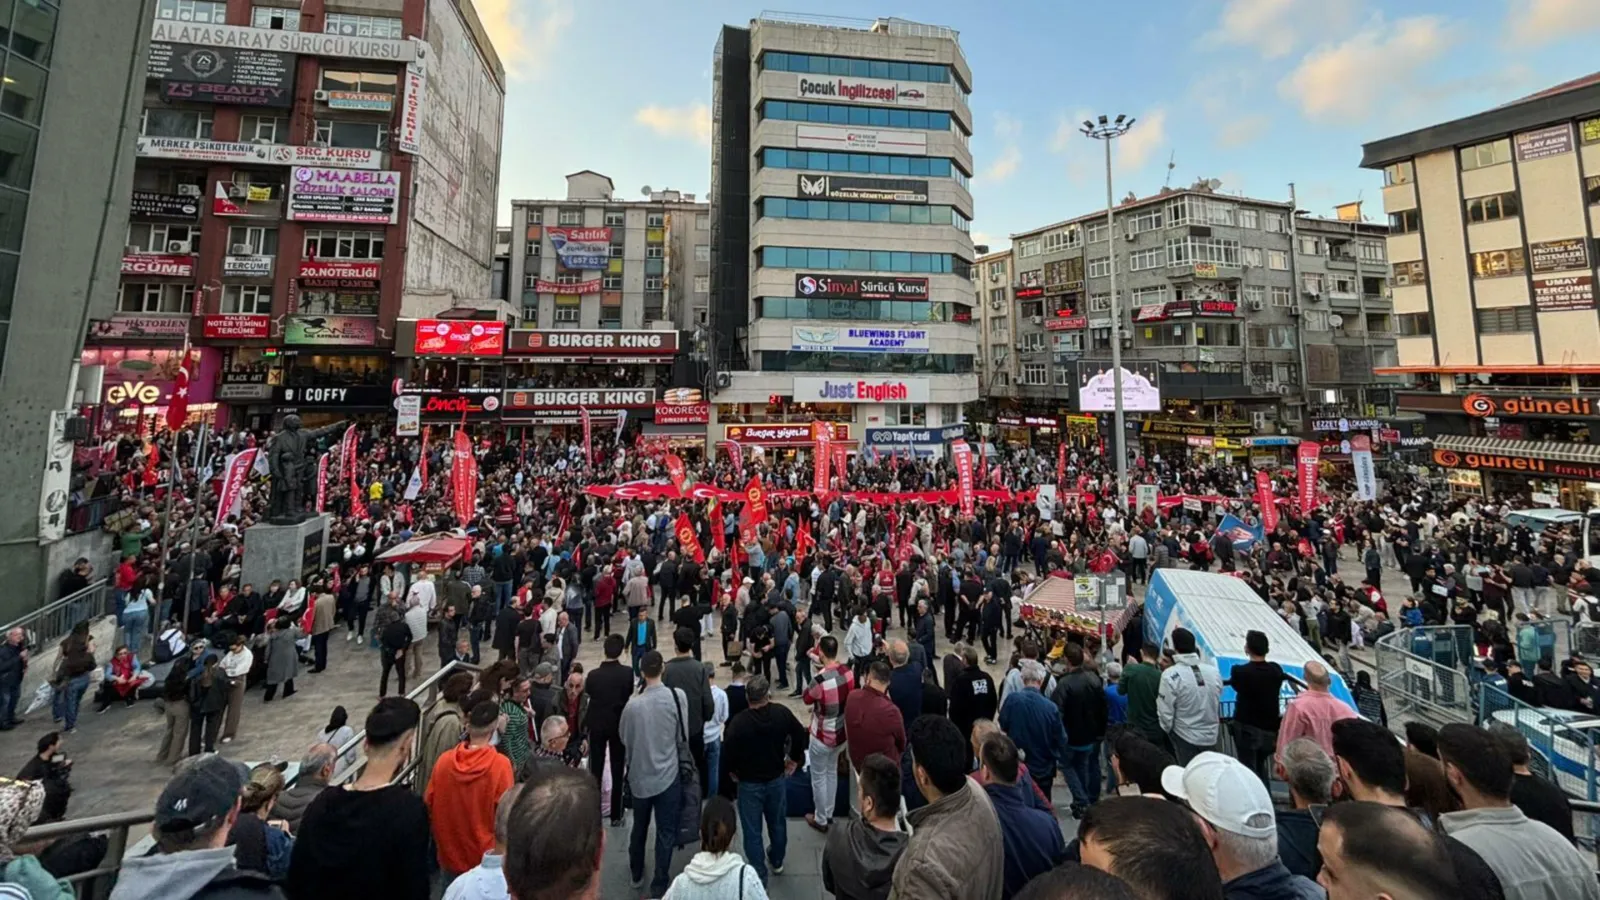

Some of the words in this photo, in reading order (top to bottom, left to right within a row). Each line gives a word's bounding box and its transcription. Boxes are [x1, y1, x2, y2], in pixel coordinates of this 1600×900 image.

[154, 23, 276, 50] ALATASARAY
[279, 32, 345, 55] SÜRÜCÜ
[348, 40, 400, 59] KURSU
[800, 78, 836, 97] Çocuk
[150, 139, 190, 150] MERKEZ
[193, 142, 255, 153] PSİKOTEKNİK
[296, 148, 321, 156] SRC
[327, 149, 371, 159] KURSU
[294, 181, 346, 195] GÜZELLİK
[350, 187, 397, 196] SALONU
[571, 229, 607, 240] Satılık
[301, 266, 377, 278] 20.NOTERLİĞİ
[819, 278, 858, 296] Sinyal
[861, 280, 895, 293] Sürücü
[898, 281, 926, 294] Kursu
[1545, 278, 1578, 286] UMAY
[1535, 285, 1592, 296] TERCÜME
[217, 327, 256, 335] TERCÜME
[849, 329, 896, 339] BLUEWINGS
[898, 331, 927, 340] FLIGHT
[549, 334, 615, 347] BURGER
[620, 335, 662, 348] KING
[869, 339, 905, 347] ACADEMY
[227, 373, 248, 381] BLACK
[107, 381, 161, 404] eve
[305, 388, 347, 402] COFFY
[819, 381, 855, 399] Just
[856, 381, 907, 401] English
[533, 392, 600, 405] BURGER
[604, 392, 646, 405] KING
[1503, 396, 1591, 416] güneli
[1312, 420, 1339, 429] LEZZET
[746, 428, 774, 439] Burger
[893, 431, 930, 442] YapıKredi
[1465, 452, 1545, 472] güneli
